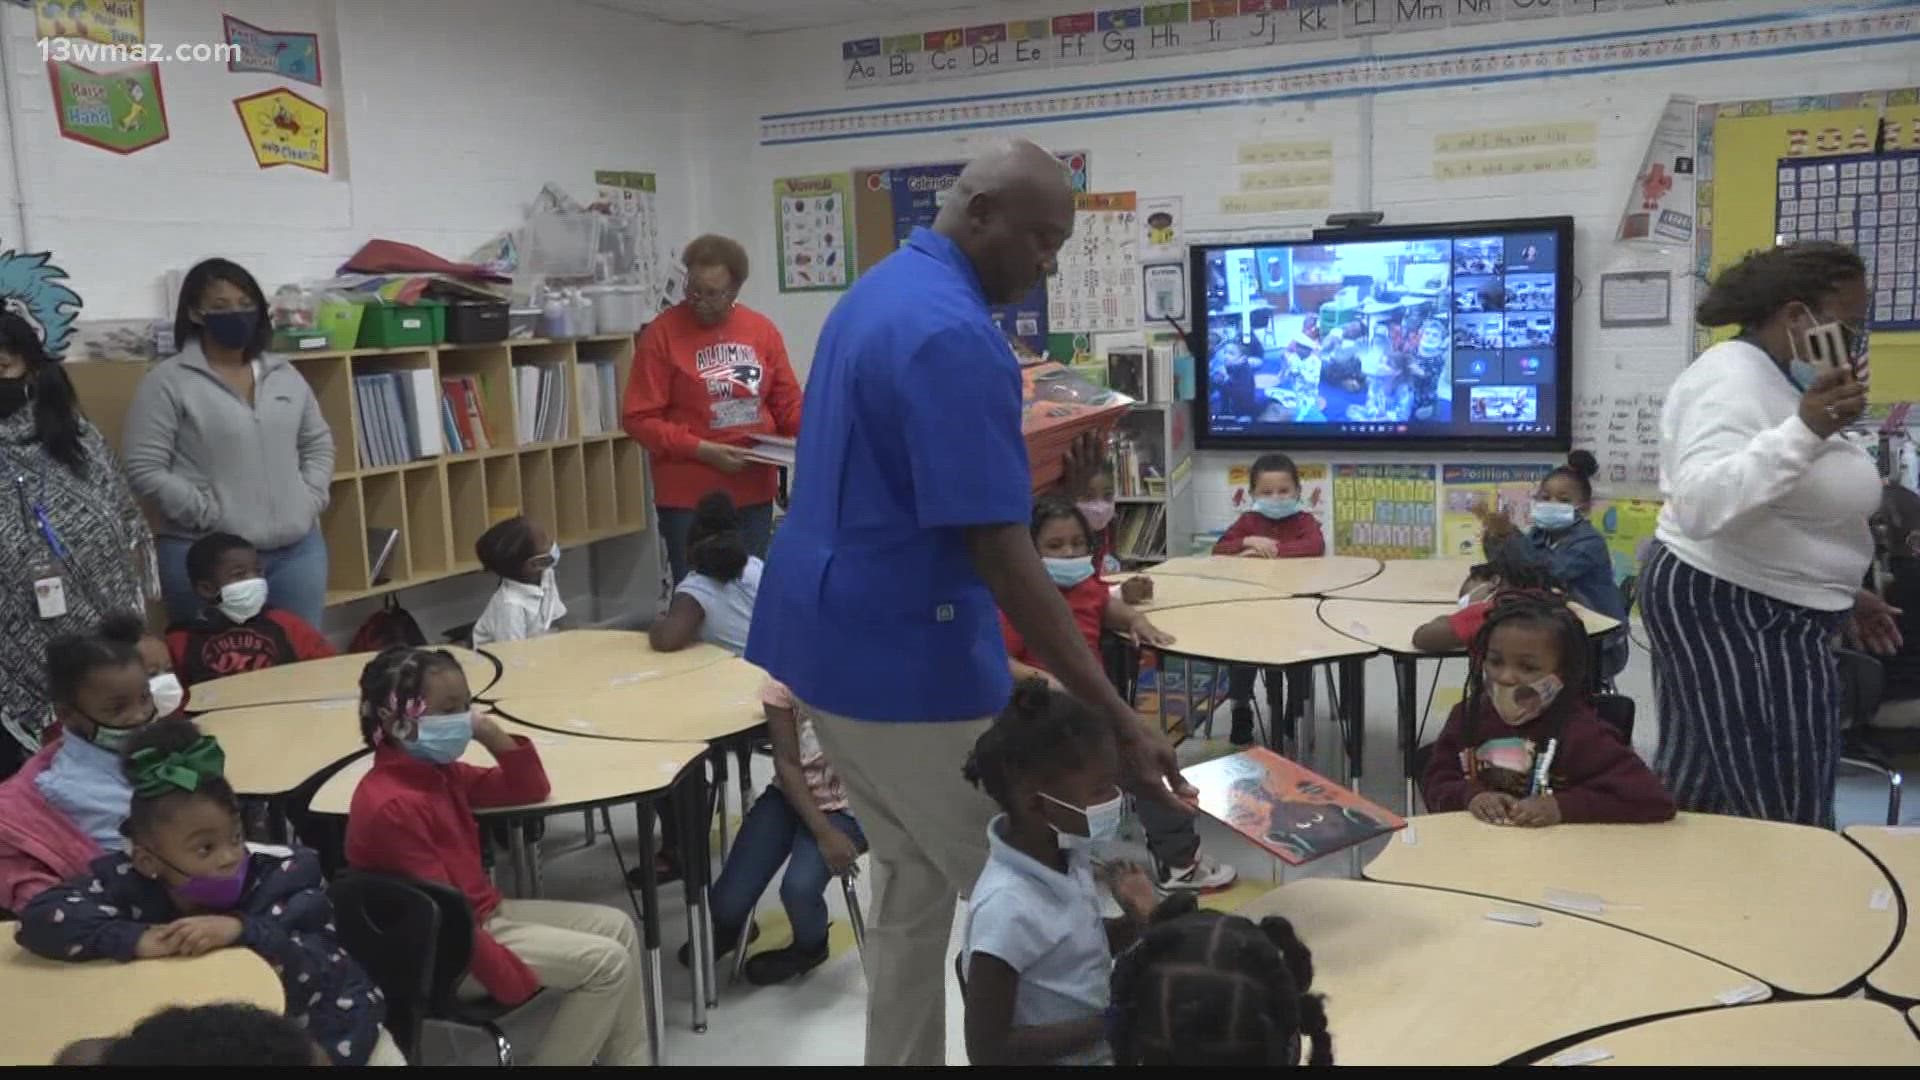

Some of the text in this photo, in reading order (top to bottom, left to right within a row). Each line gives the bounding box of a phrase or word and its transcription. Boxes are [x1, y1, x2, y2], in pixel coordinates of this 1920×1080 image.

[848, 59, 876, 80] Aa
[889, 54, 915, 77] Bb
[931, 50, 958, 71] Cc
[971, 44, 1001, 67] Dd
[1016, 39, 1041, 62] Ee
[1060, 34, 1088, 58] Ff
[1103, 30, 1136, 60] Gg
[1151, 26, 1180, 50] Hh
[1207, 18, 1222, 43] Ii
[1248, 12, 1278, 46] Jj
[1298, 7, 1328, 33] Kk
[1396, 0, 1442, 23] Mm
[784, 177, 833, 193] Vowels
[695, 344, 757, 369] ALUMNI
